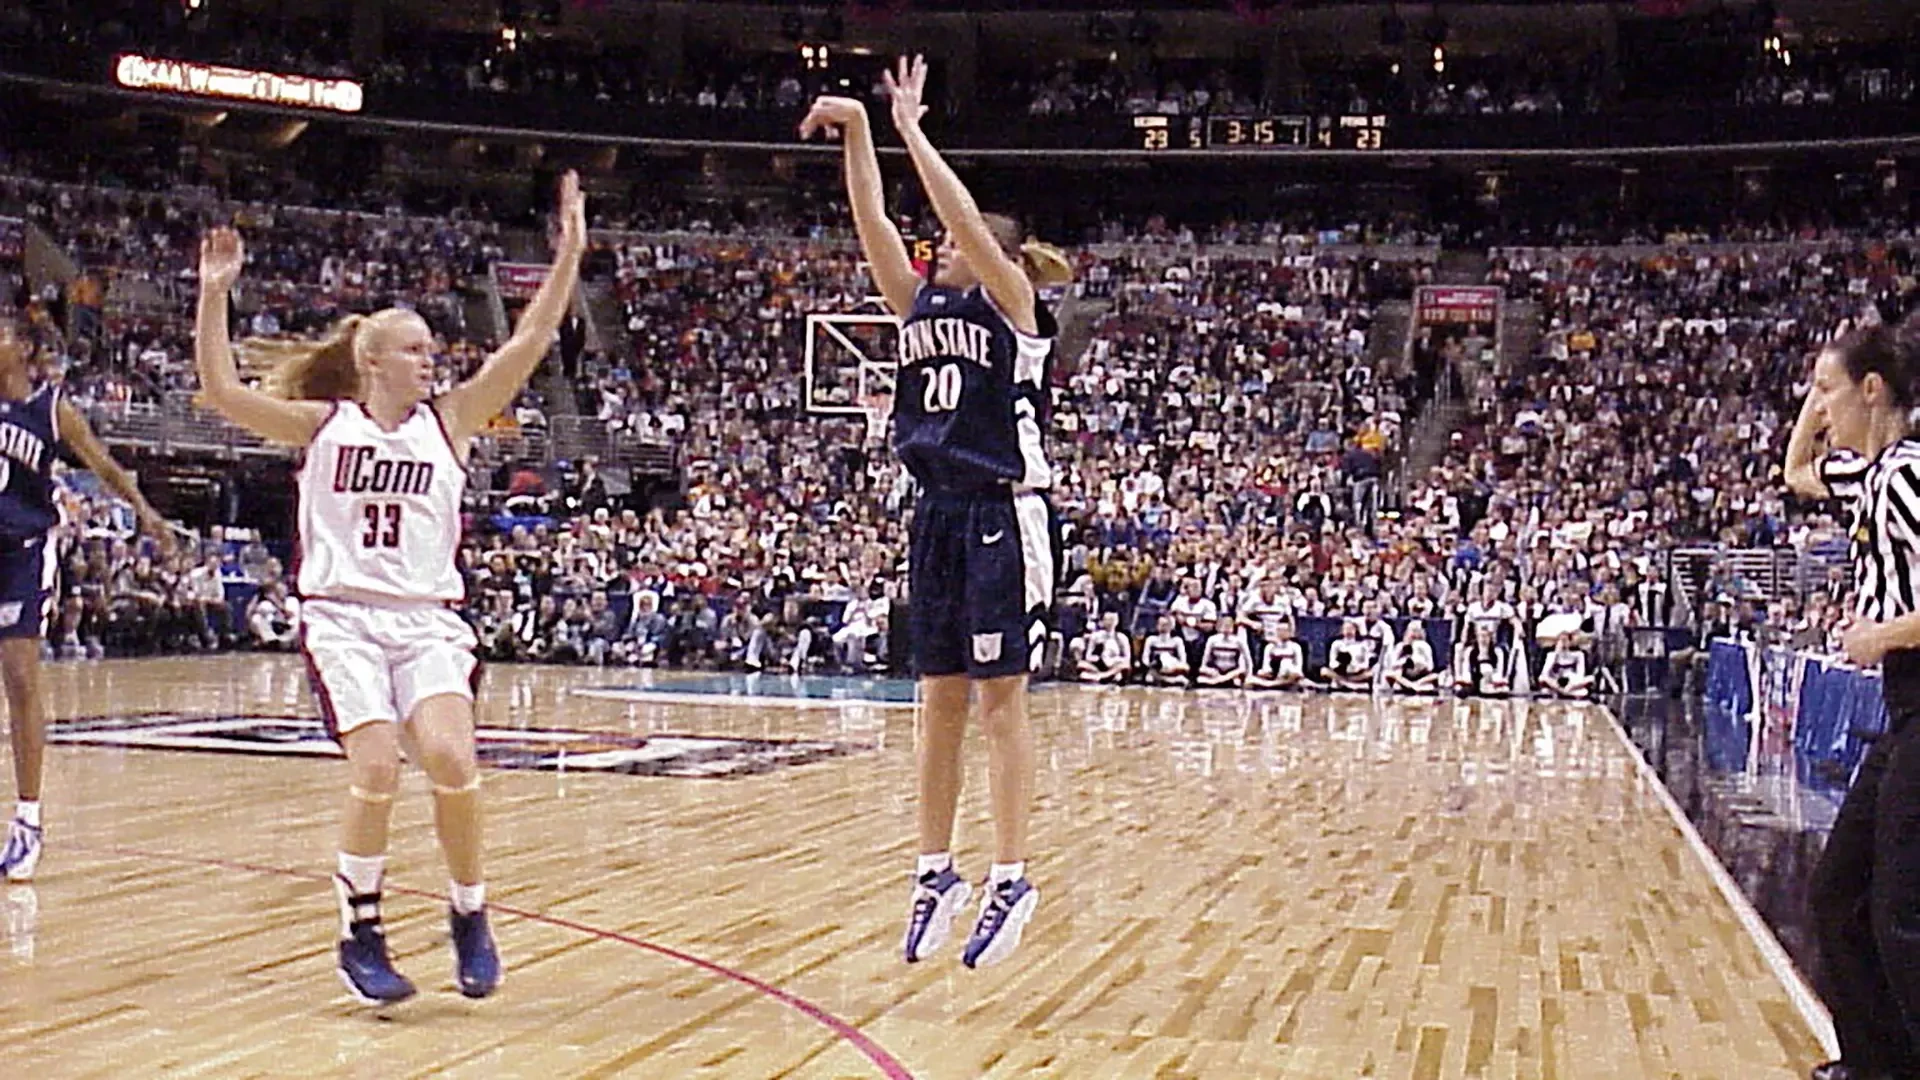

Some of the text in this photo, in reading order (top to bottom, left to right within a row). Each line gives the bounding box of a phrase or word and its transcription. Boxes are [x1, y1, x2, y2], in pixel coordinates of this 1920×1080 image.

[1356, 129, 1382, 148] 23
[934, 317, 993, 369] STATE
[921, 363, 963, 413] 20
[333, 445, 434, 494] UConn
[362, 503, 402, 548] 33
